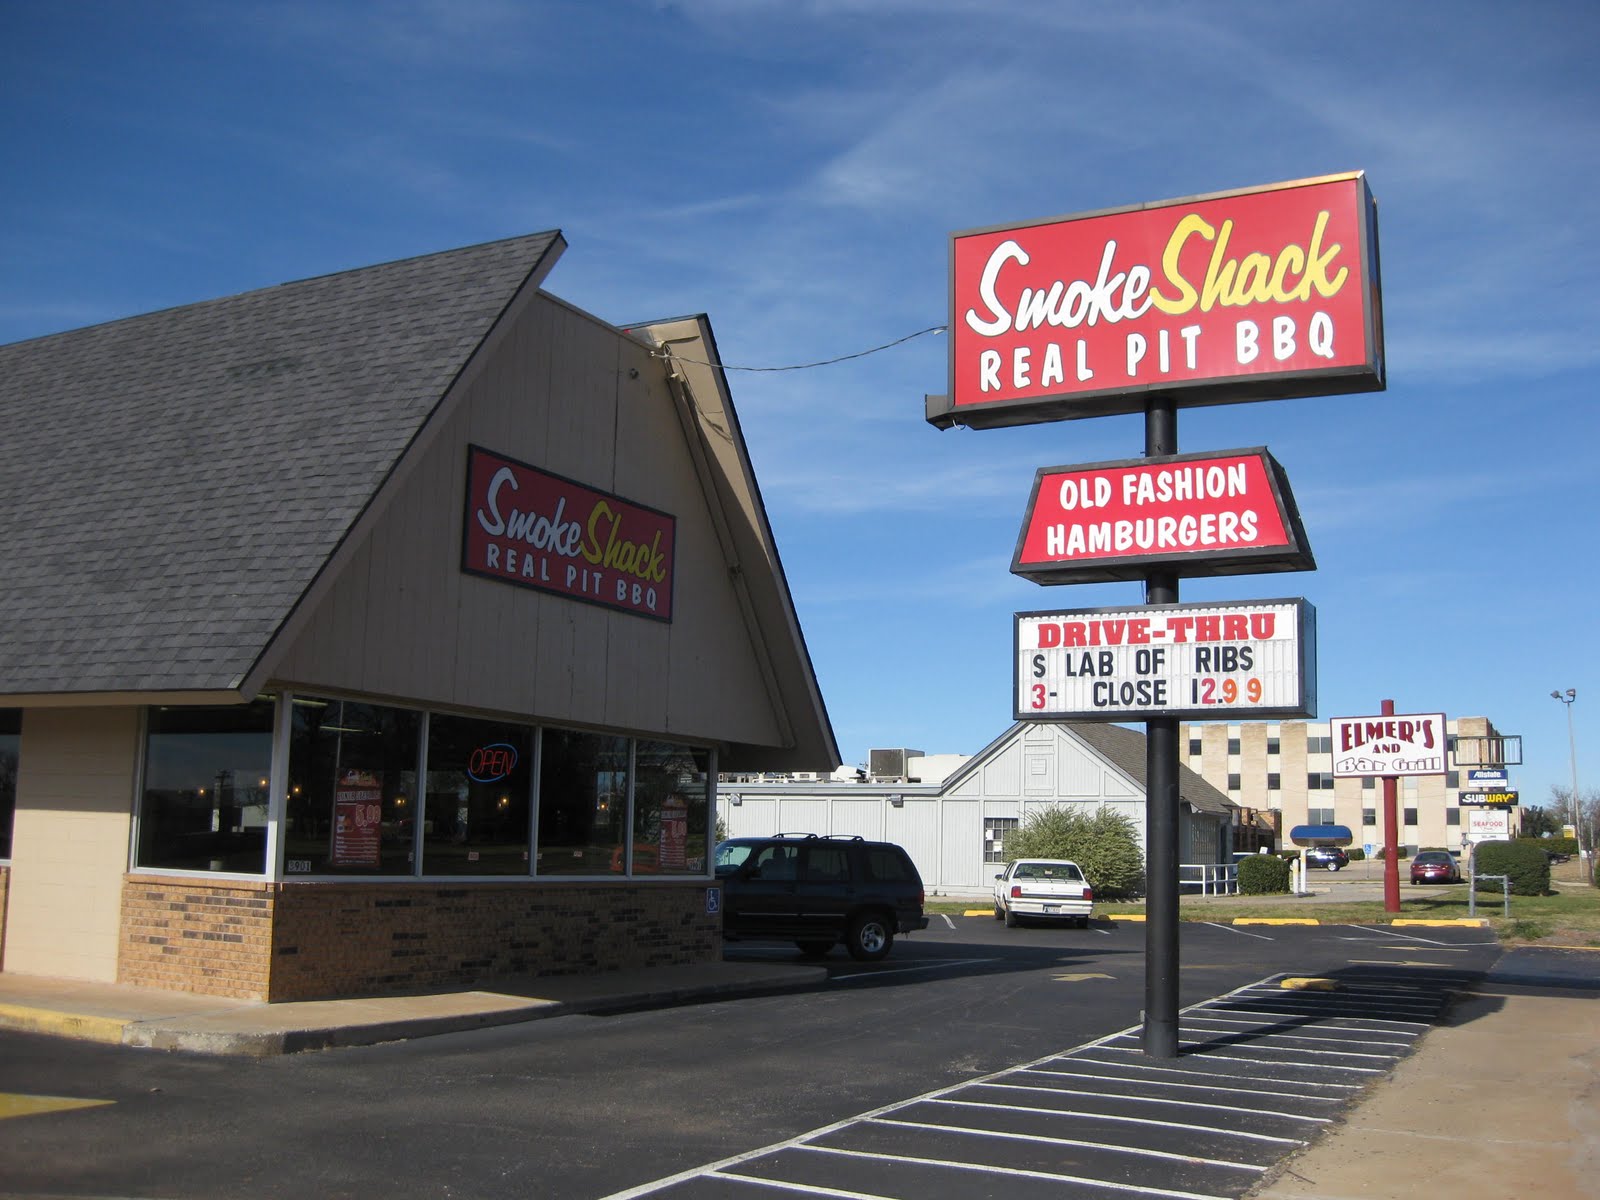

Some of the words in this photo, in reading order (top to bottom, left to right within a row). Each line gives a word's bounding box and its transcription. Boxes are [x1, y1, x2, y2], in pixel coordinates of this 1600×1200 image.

[966, 240, 1153, 336] Smoke
[1149, 211, 1348, 314] Shack
[980, 340, 1094, 392] REAL
[1127, 325, 1201, 377] PIT
[1236, 312, 1334, 365] BBQ
[1060, 477, 1112, 510] OLD
[1123, 463, 1247, 505] FASHION
[477, 467, 582, 558] Smoke
[580, 500, 666, 583] Shack
[1047, 509, 1258, 556] HAMBURGERS
[487, 543, 550, 581] REAL
[567, 565, 602, 594] PIT
[616, 579, 657, 611] BBQ
[1037, 613, 1276, 648] DRIVE-THRU
[1136, 649, 1165, 675] OF
[1196, 646, 1254, 673] RIBS
[1093, 680, 1167, 707] CLOSE
[1341, 720, 1435, 752] ELMER'S
[1372, 743, 1401, 753] AND
[470, 748, 515, 775] OPEN
[1336, 757, 1387, 773] Bar
[1392, 757, 1441, 771] Grill
[1462, 794, 1514, 803] SUBWAY
